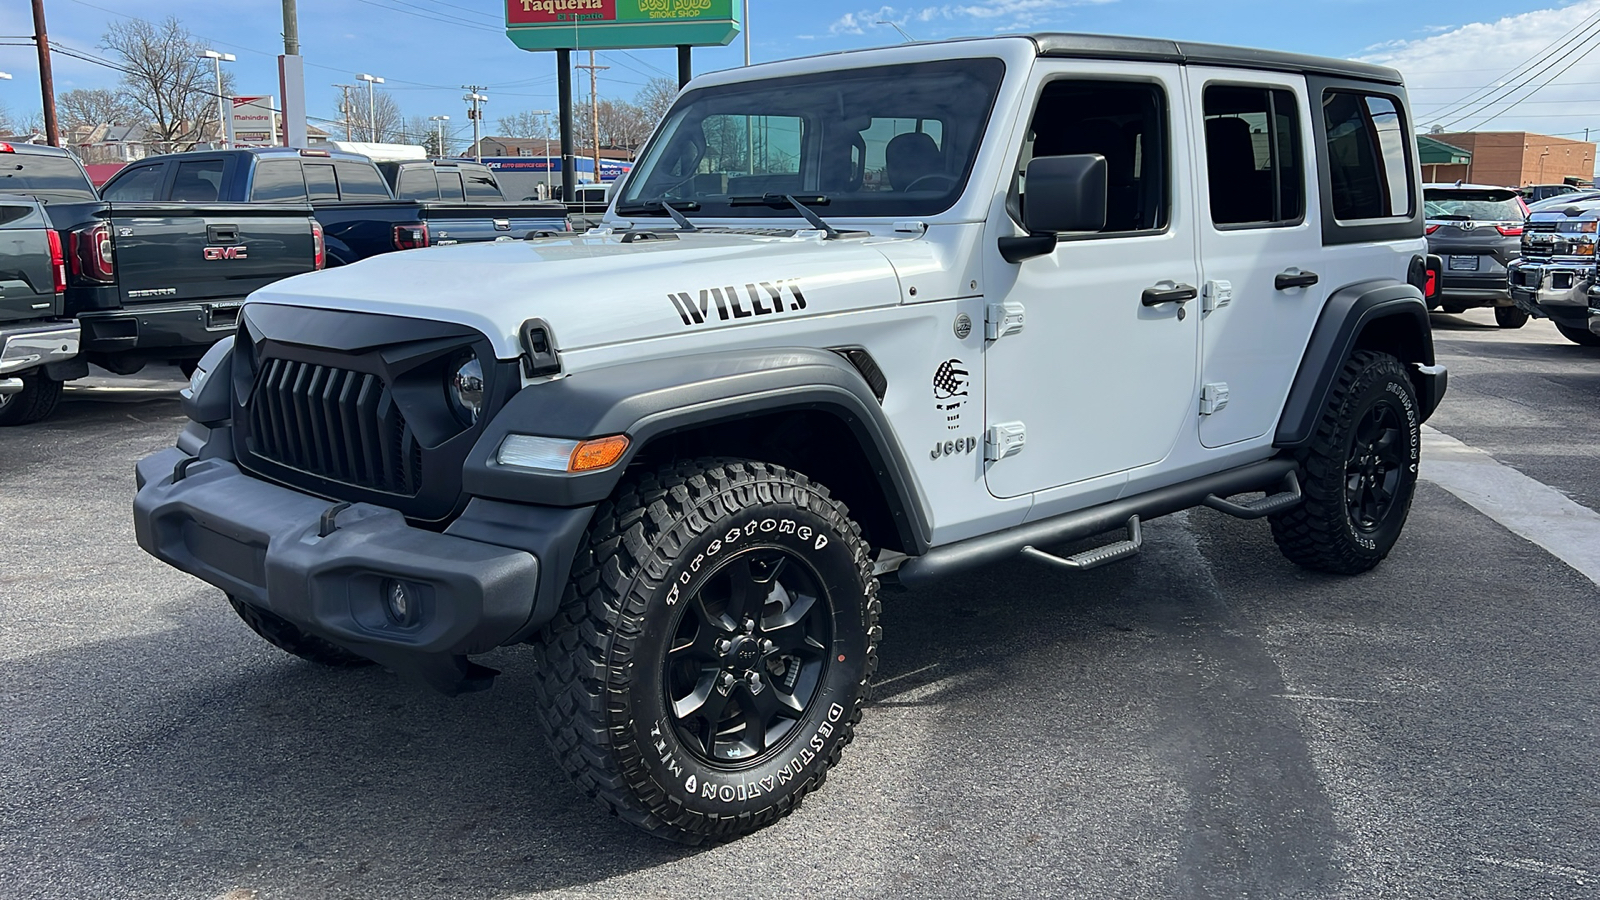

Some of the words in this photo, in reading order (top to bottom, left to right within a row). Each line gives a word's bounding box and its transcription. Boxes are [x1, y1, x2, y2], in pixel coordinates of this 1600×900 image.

[520, 0, 603, 14] Taqueria
[203, 245, 248, 261] GMC
[128, 288, 177, 299] SIERRA
[667, 278, 807, 325] WILLYS
[930, 436, 977, 461] Jeep
[666, 518, 812, 606] Firestone
[702, 702, 844, 802] DESTINATION
